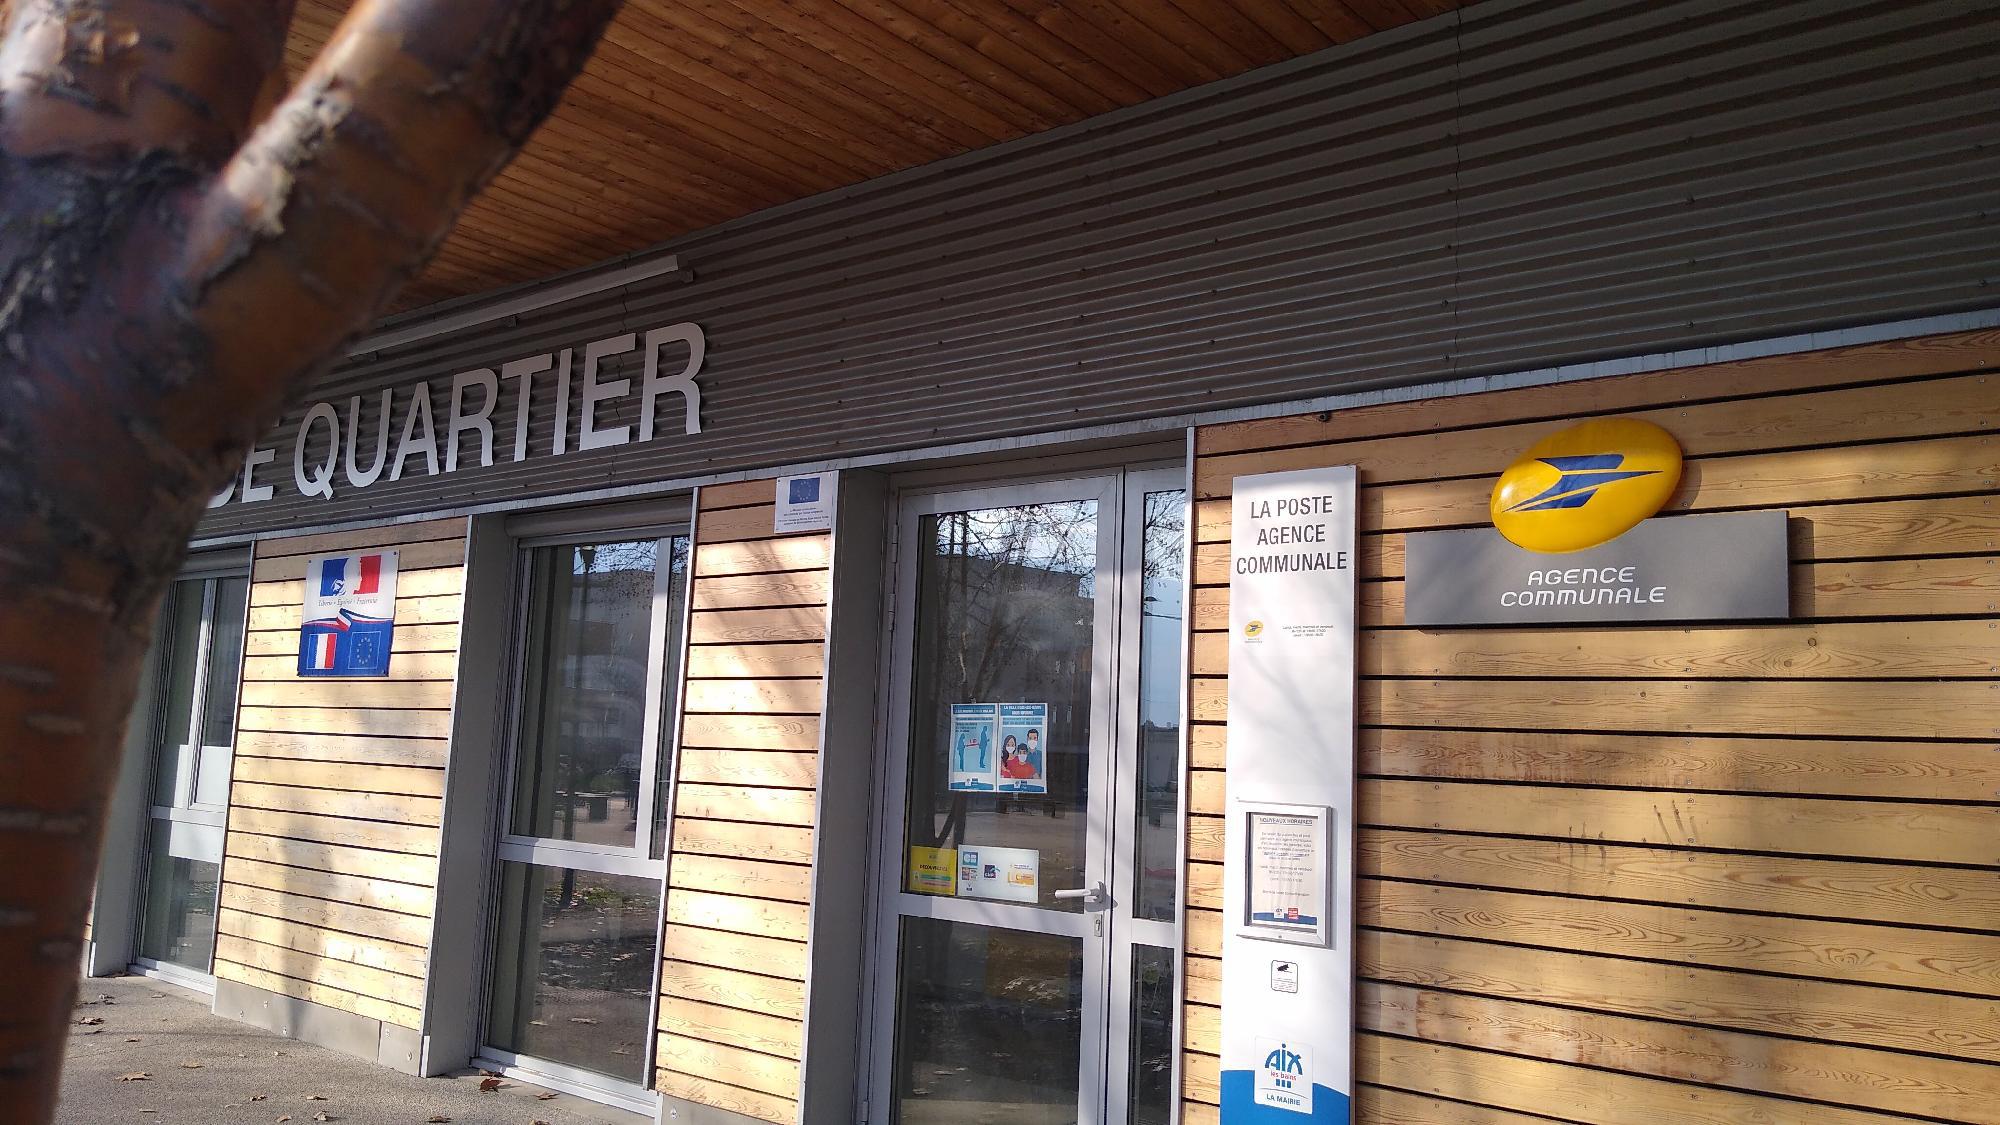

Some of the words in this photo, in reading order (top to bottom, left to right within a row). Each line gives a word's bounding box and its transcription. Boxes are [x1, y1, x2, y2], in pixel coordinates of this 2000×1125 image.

[207, 416, 280, 509] E
[294, 321, 706, 500] QUARTIER
[1250, 500, 1271, 519] LA
[1277, 495, 1333, 517] POSTE
[1256, 523, 1326, 546] AGENCE
[1236, 551, 1348, 575] COMMUNALE
[1527, 566, 1636, 586] AGENCE
[1500, 586, 1667, 607] COMMUNALE
[1266, 1093, 1275, 1101] LA
[1276, 1095, 1301, 1106] MAIRIE
